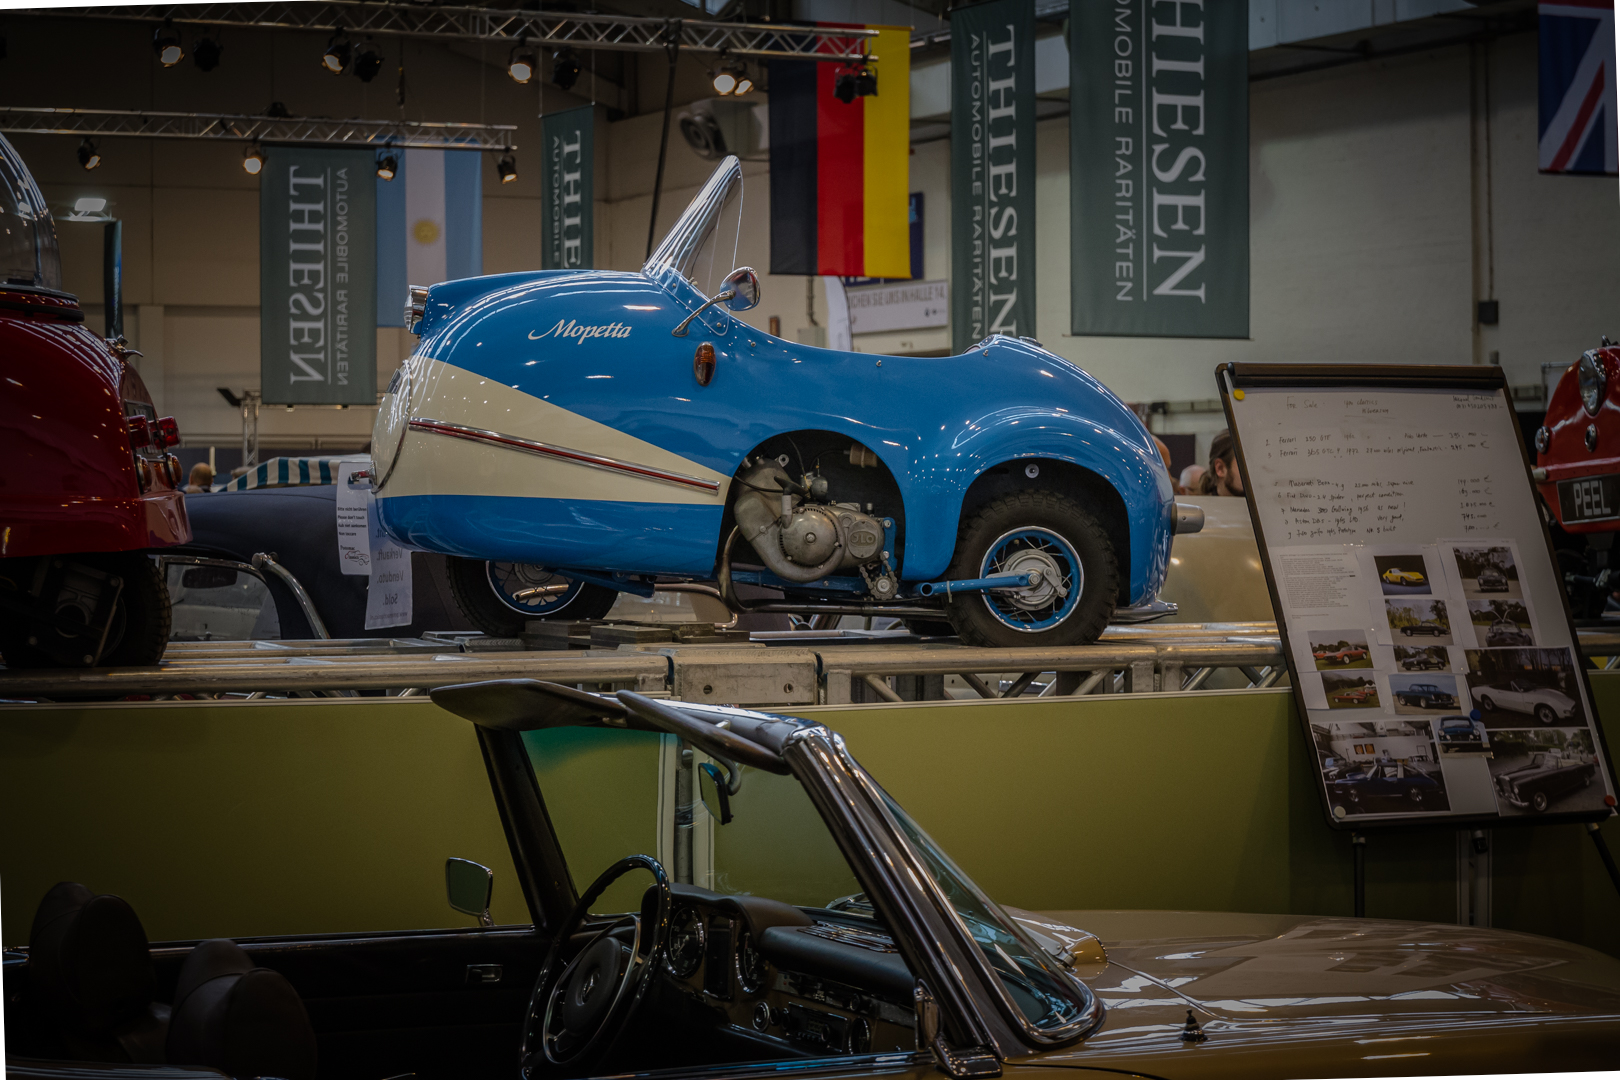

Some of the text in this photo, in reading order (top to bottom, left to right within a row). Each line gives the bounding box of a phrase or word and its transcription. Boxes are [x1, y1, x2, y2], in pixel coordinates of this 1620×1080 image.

[970, 33, 984, 340] AUTOMOBILE RARITÄTEN
[988, 24, 1018, 338] THIESEN
[1114, 0, 1137, 302] MOBILE RARITÄTEN
[552, 135, 561, 263] AUTOMOBILE
[528, 319, 632, 345] Mopetta
[1279, 436, 1297, 445] Ferrari
[1280, 447, 1298, 457] Ferrari
[1573, 480, 1612, 517] PEEL
